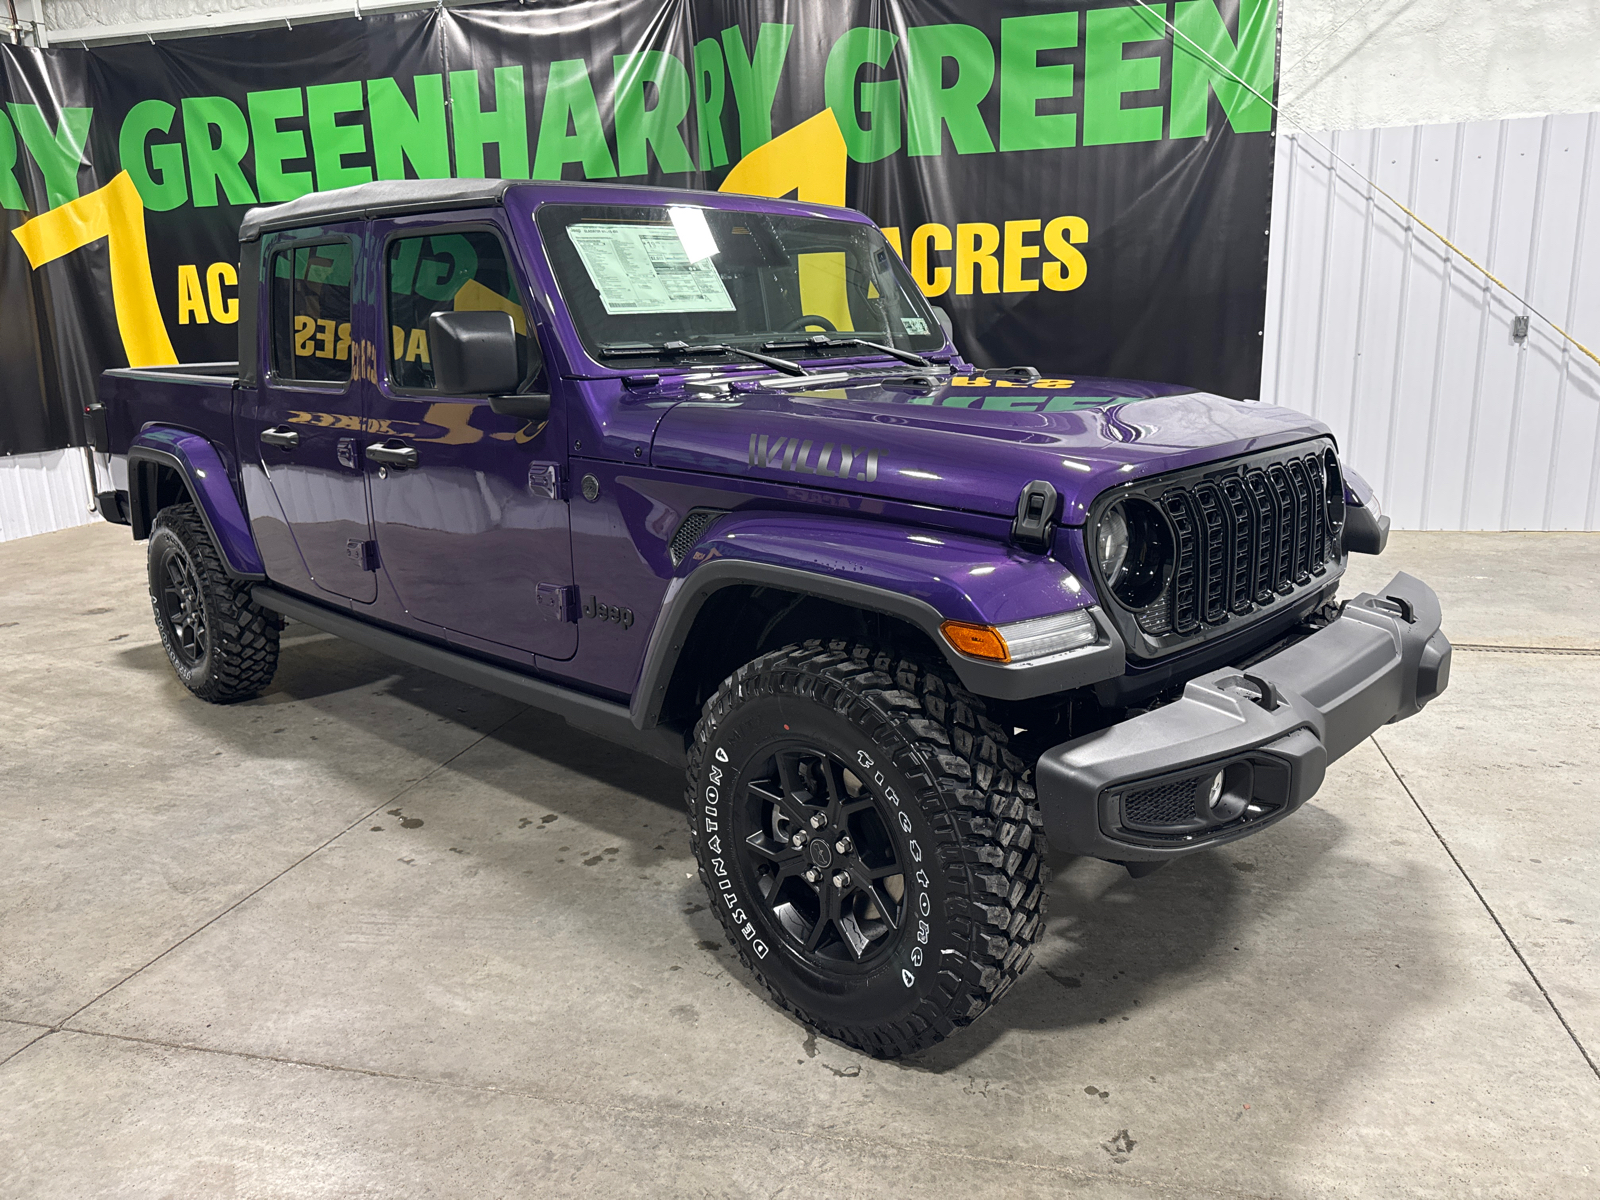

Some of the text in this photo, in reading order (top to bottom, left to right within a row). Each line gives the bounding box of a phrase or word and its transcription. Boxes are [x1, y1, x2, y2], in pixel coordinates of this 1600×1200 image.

[449, 0, 1276, 181] HARRY GREEN
[118, 73, 452, 212] GREEN
[178, 261, 240, 325] AC
[749, 433, 889, 482] WILLYS
[583, 594, 634, 630] Jeep
[705, 764, 769, 960] DESTINATION
